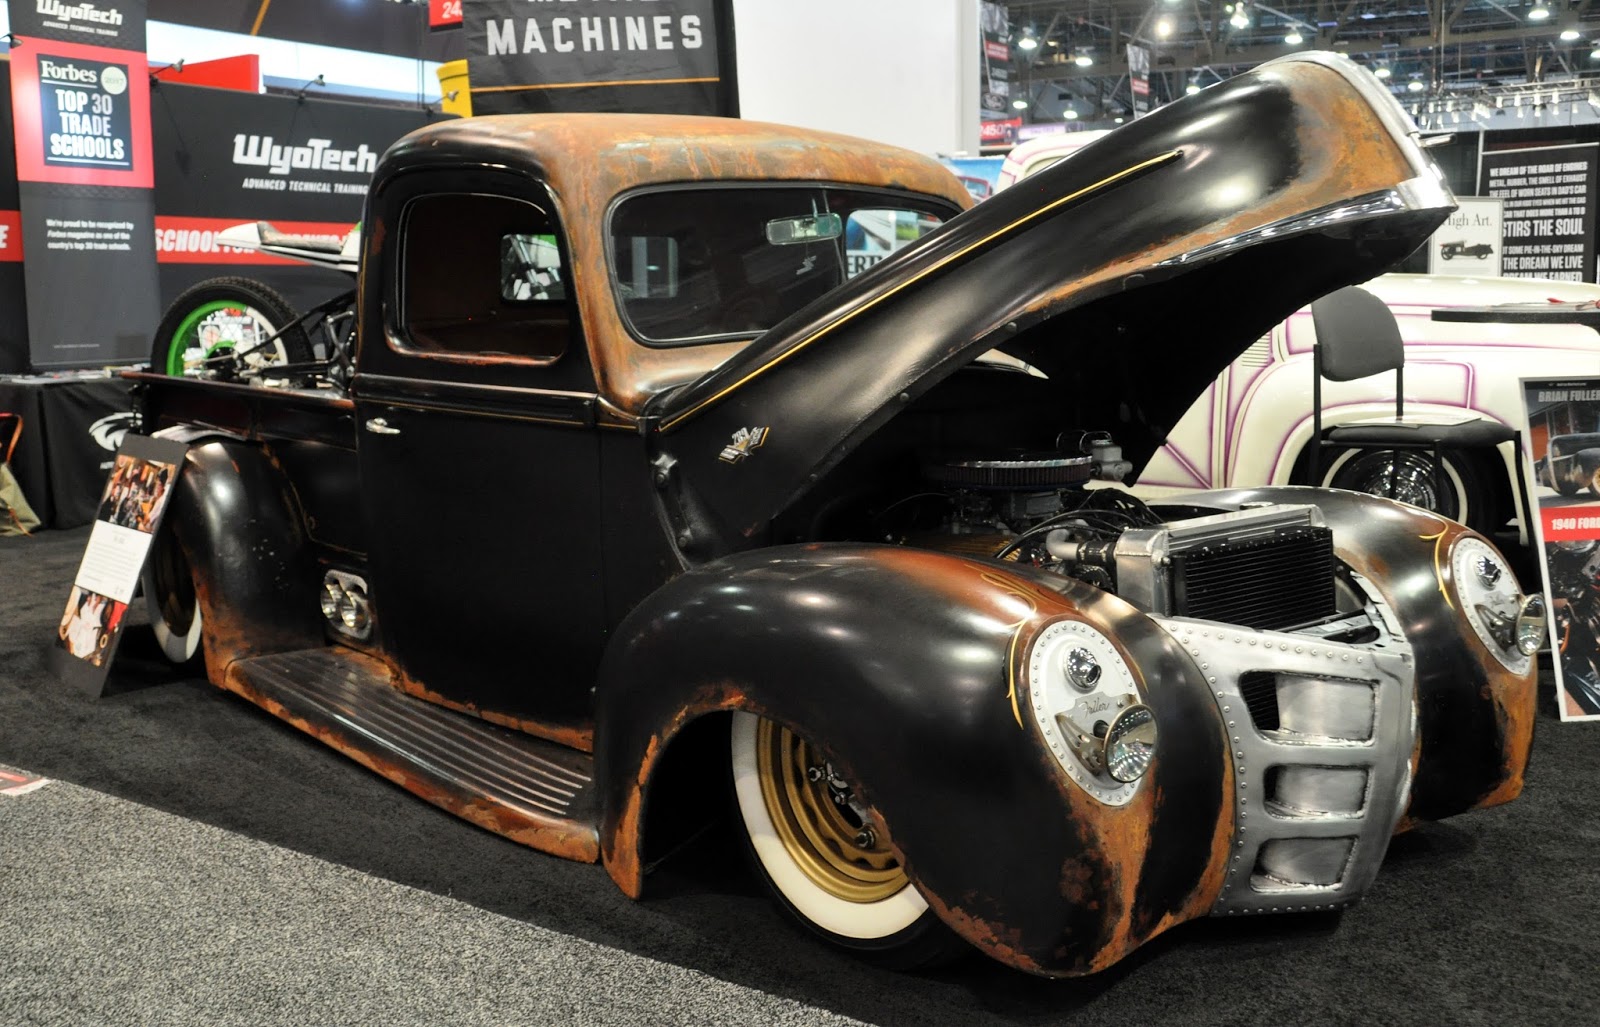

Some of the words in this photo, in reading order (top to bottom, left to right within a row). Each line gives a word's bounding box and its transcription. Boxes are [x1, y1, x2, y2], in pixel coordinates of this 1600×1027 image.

[36, 0, 123, 25] WyoTech
[442, 0, 463, 18] 24
[486, 15, 702, 55] MACHINES
[40, 60, 98, 82] Forbes
[55, 88, 88, 112] TOP
[92, 93, 112, 115] 30
[59, 112, 112, 136] TRADE
[50, 133, 124, 160] SCHOOLS
[233, 134, 378, 175] WyoTech
[1490, 168, 1499, 177] WE
[1499, 167, 1518, 176] DREAM
[1519, 166, 1526, 175] OF
[1527, 165, 1538, 174] THE
[1554, 163, 1562, 172] OF
[1562, 162, 1588, 172] ENGINES
[242, 178, 286, 190] ADVANCED
[289, 180, 331, 193] TECHNICAL
[334, 184, 369, 194] TRAINING
[1528, 177, 1538, 185] THE
[1555, 175, 1562, 184] OF
[1562, 174, 1587, 183] EXHAUST
[1511, 189, 1518, 198] OF
[1534, 187, 1551, 196] SEATS
[1551, 186, 1557, 195] IN
[1574, 185, 1586, 194] CAR
[1533, 219, 1554, 236] THE
[1555, 218, 1585, 235] SOUL
[155, 228, 220, 252] SCHOOL
[1563, 244, 1584, 253] DREAM
[1503, 257, 1519, 270] THE
[1520, 256, 1549, 270] DREAM
[1550, 256, 1564, 269] WE
[1564, 255, 1583, 268] LIVE
[1538, 390, 1568, 402] BRIAN
[1551, 518, 1576, 530] 1940
